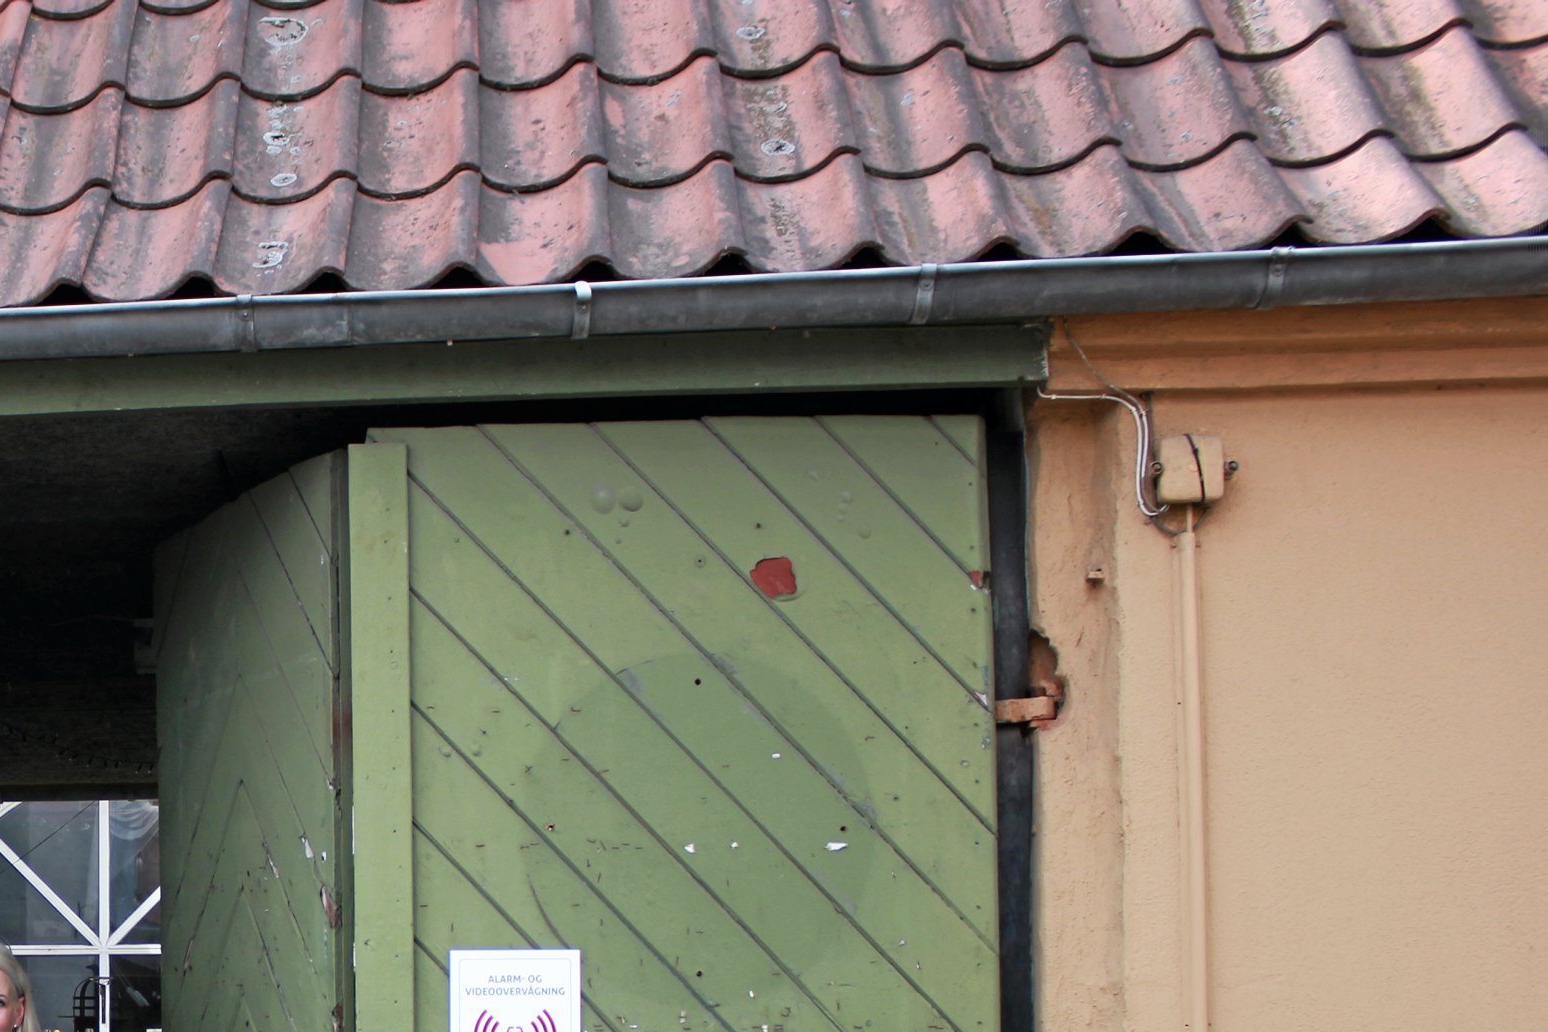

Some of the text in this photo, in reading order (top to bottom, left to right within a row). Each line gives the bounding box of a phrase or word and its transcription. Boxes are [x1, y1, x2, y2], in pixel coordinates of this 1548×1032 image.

[488, 974, 543, 984] ALARM- OG
[465, 985, 566, 996] VIDEOOVERVÅGNING
